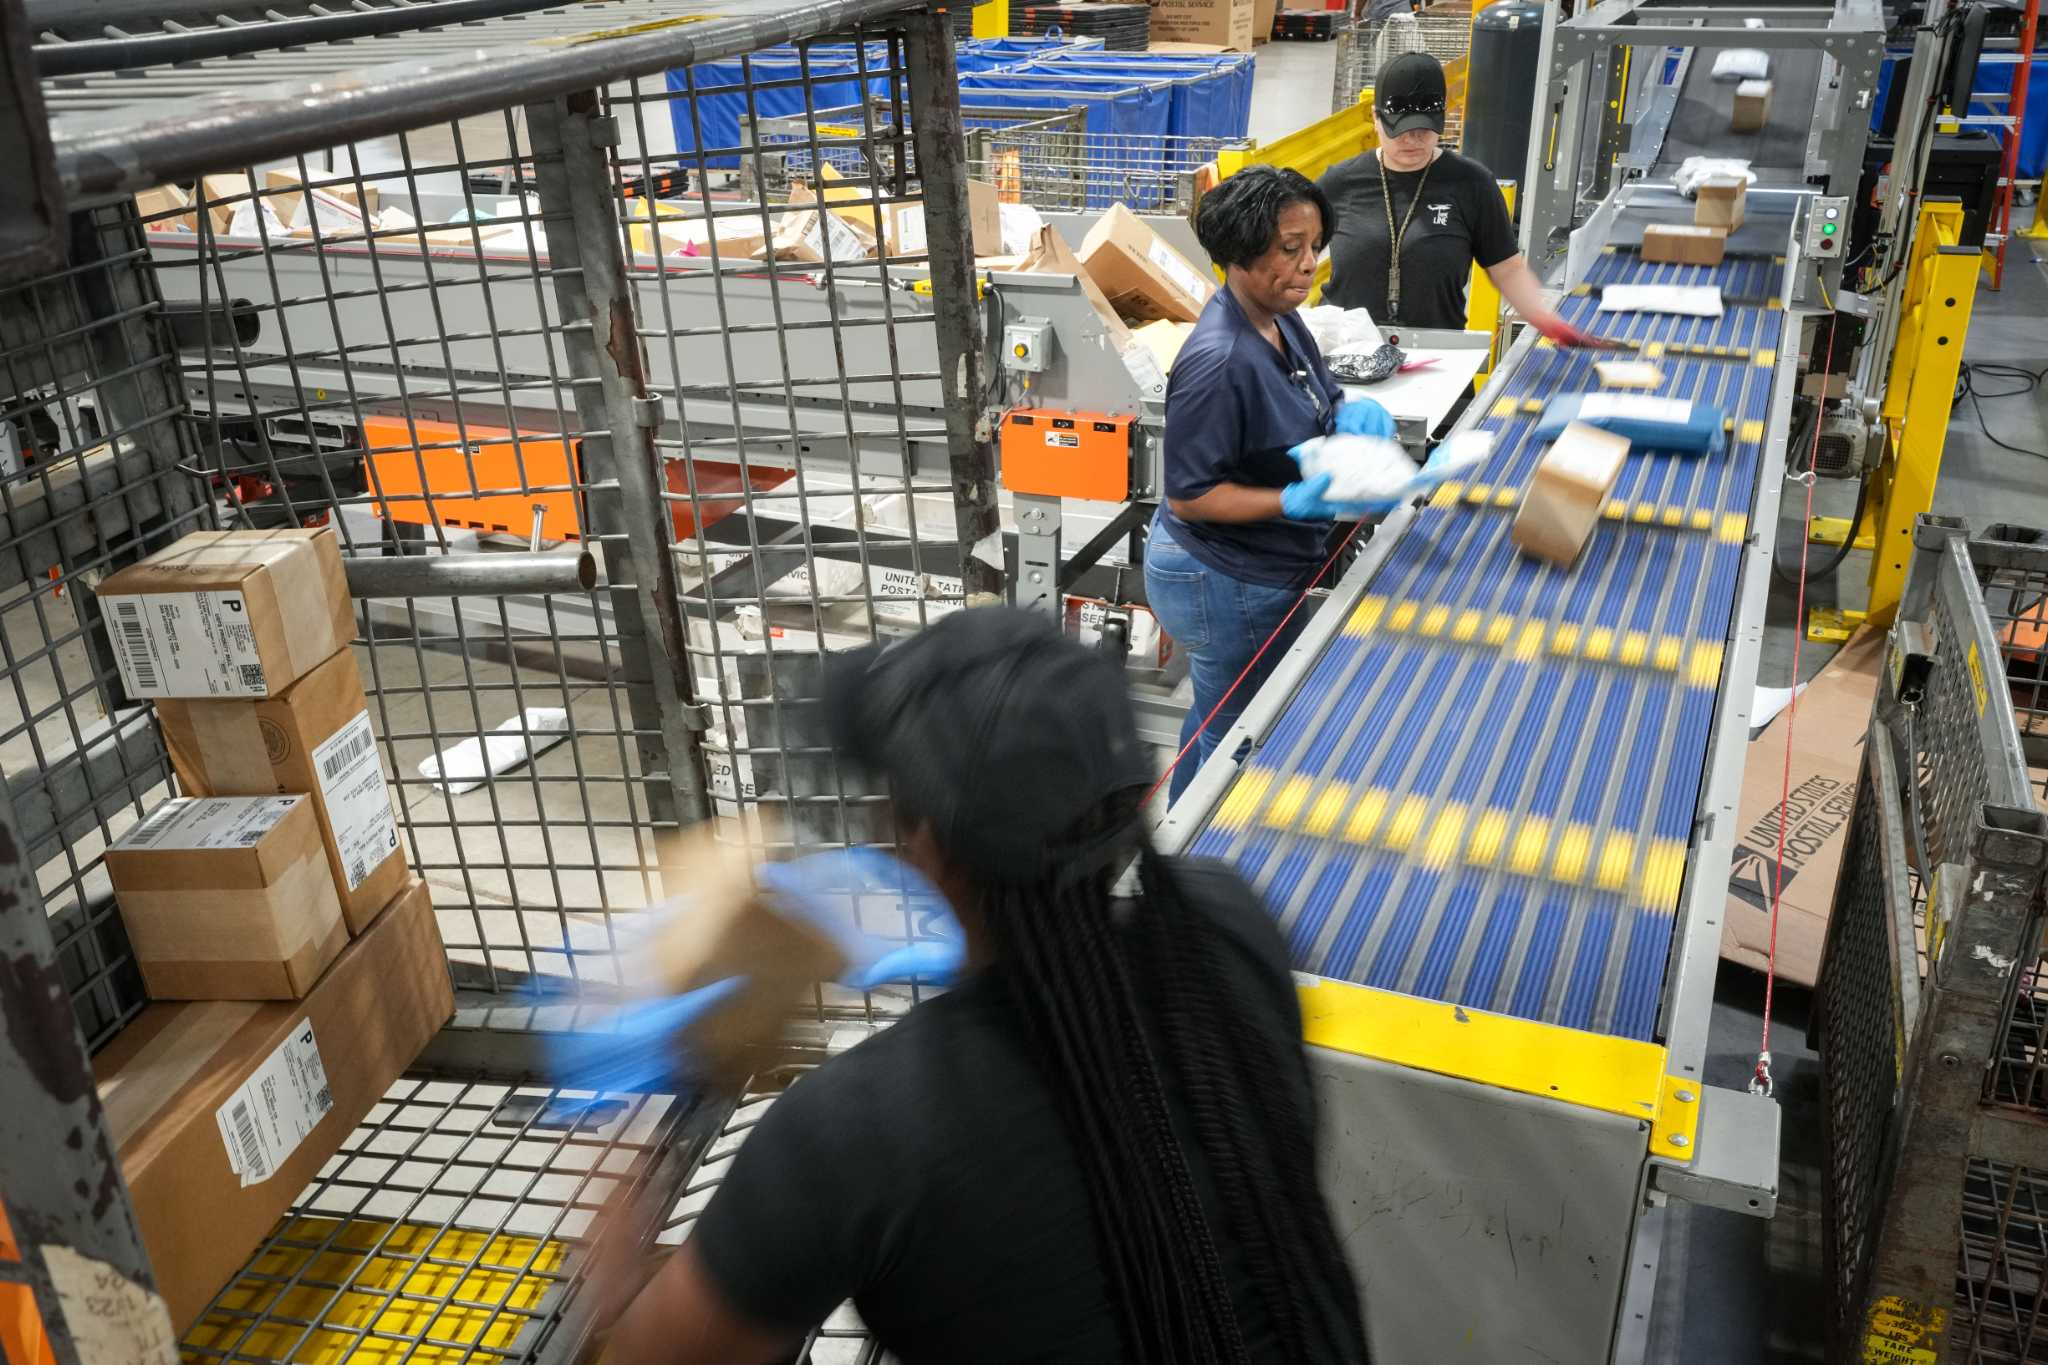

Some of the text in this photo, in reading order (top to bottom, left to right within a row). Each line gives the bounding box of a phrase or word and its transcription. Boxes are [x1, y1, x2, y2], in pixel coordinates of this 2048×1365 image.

[885, 572, 964, 593] UNITE TATE
[222, 600, 242, 612] P
[1743, 774, 1841, 849] UNITED STATES
[1780, 815, 1843, 868] POSTAL
[299, 1030, 313, 1045] P
